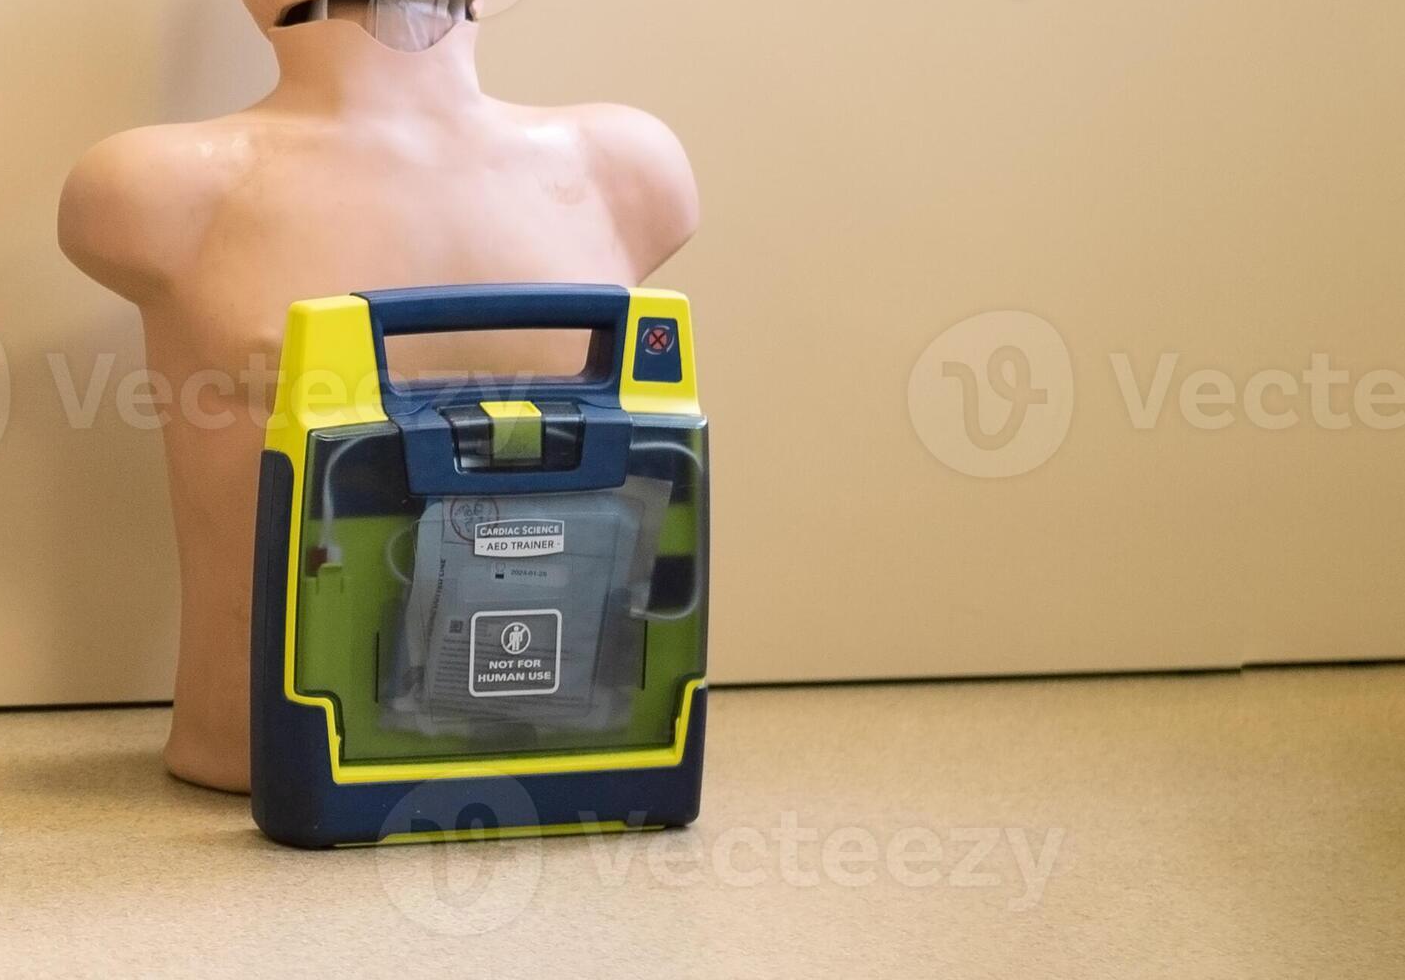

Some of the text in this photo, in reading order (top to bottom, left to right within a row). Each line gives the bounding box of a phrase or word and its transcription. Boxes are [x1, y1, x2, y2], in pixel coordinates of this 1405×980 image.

[479, 524, 559, 536] CARDIAC SCIENCE
[486, 539, 554, 551] AED TRAINER
[488, 658, 541, 669] NOT FOR
[477, 671, 552, 683] HUMAN USE
